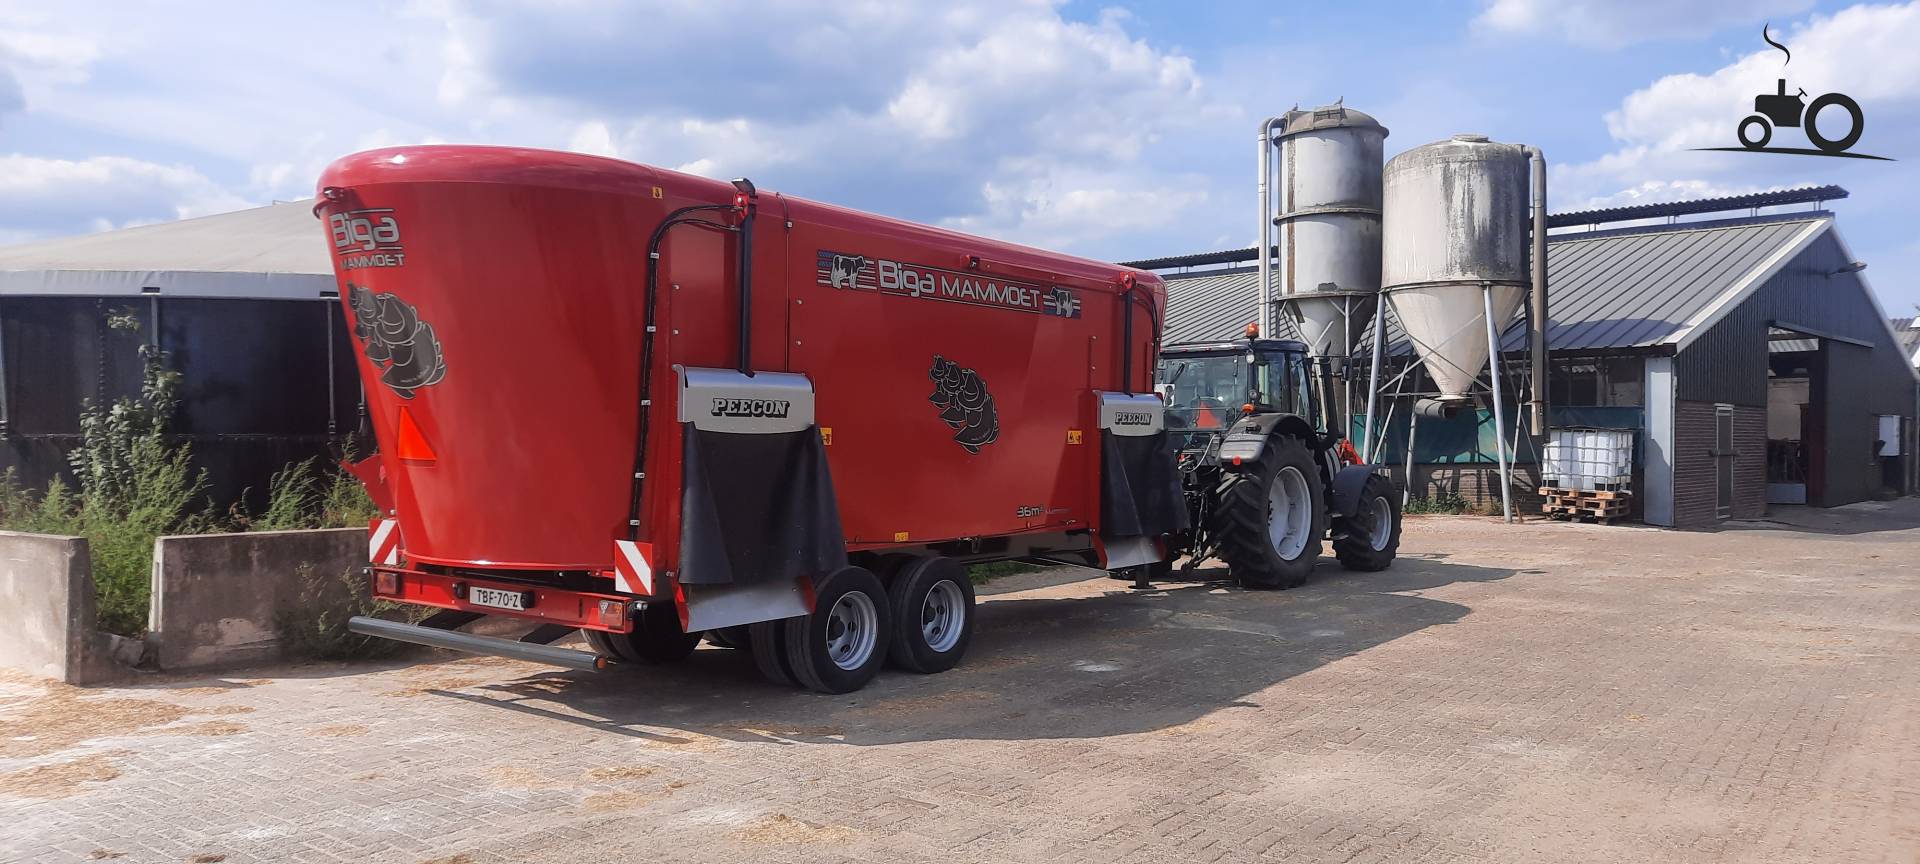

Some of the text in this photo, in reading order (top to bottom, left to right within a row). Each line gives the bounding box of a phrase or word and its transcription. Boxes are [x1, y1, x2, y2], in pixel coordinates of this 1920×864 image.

[329, 212, 400, 251] Biga
[342, 254, 405, 270] MAMMOET
[878, 259, 1040, 308] Biga MAMMOET
[711, 398, 790, 418] PEECON
[1115, 411, 1152, 425] PEECON
